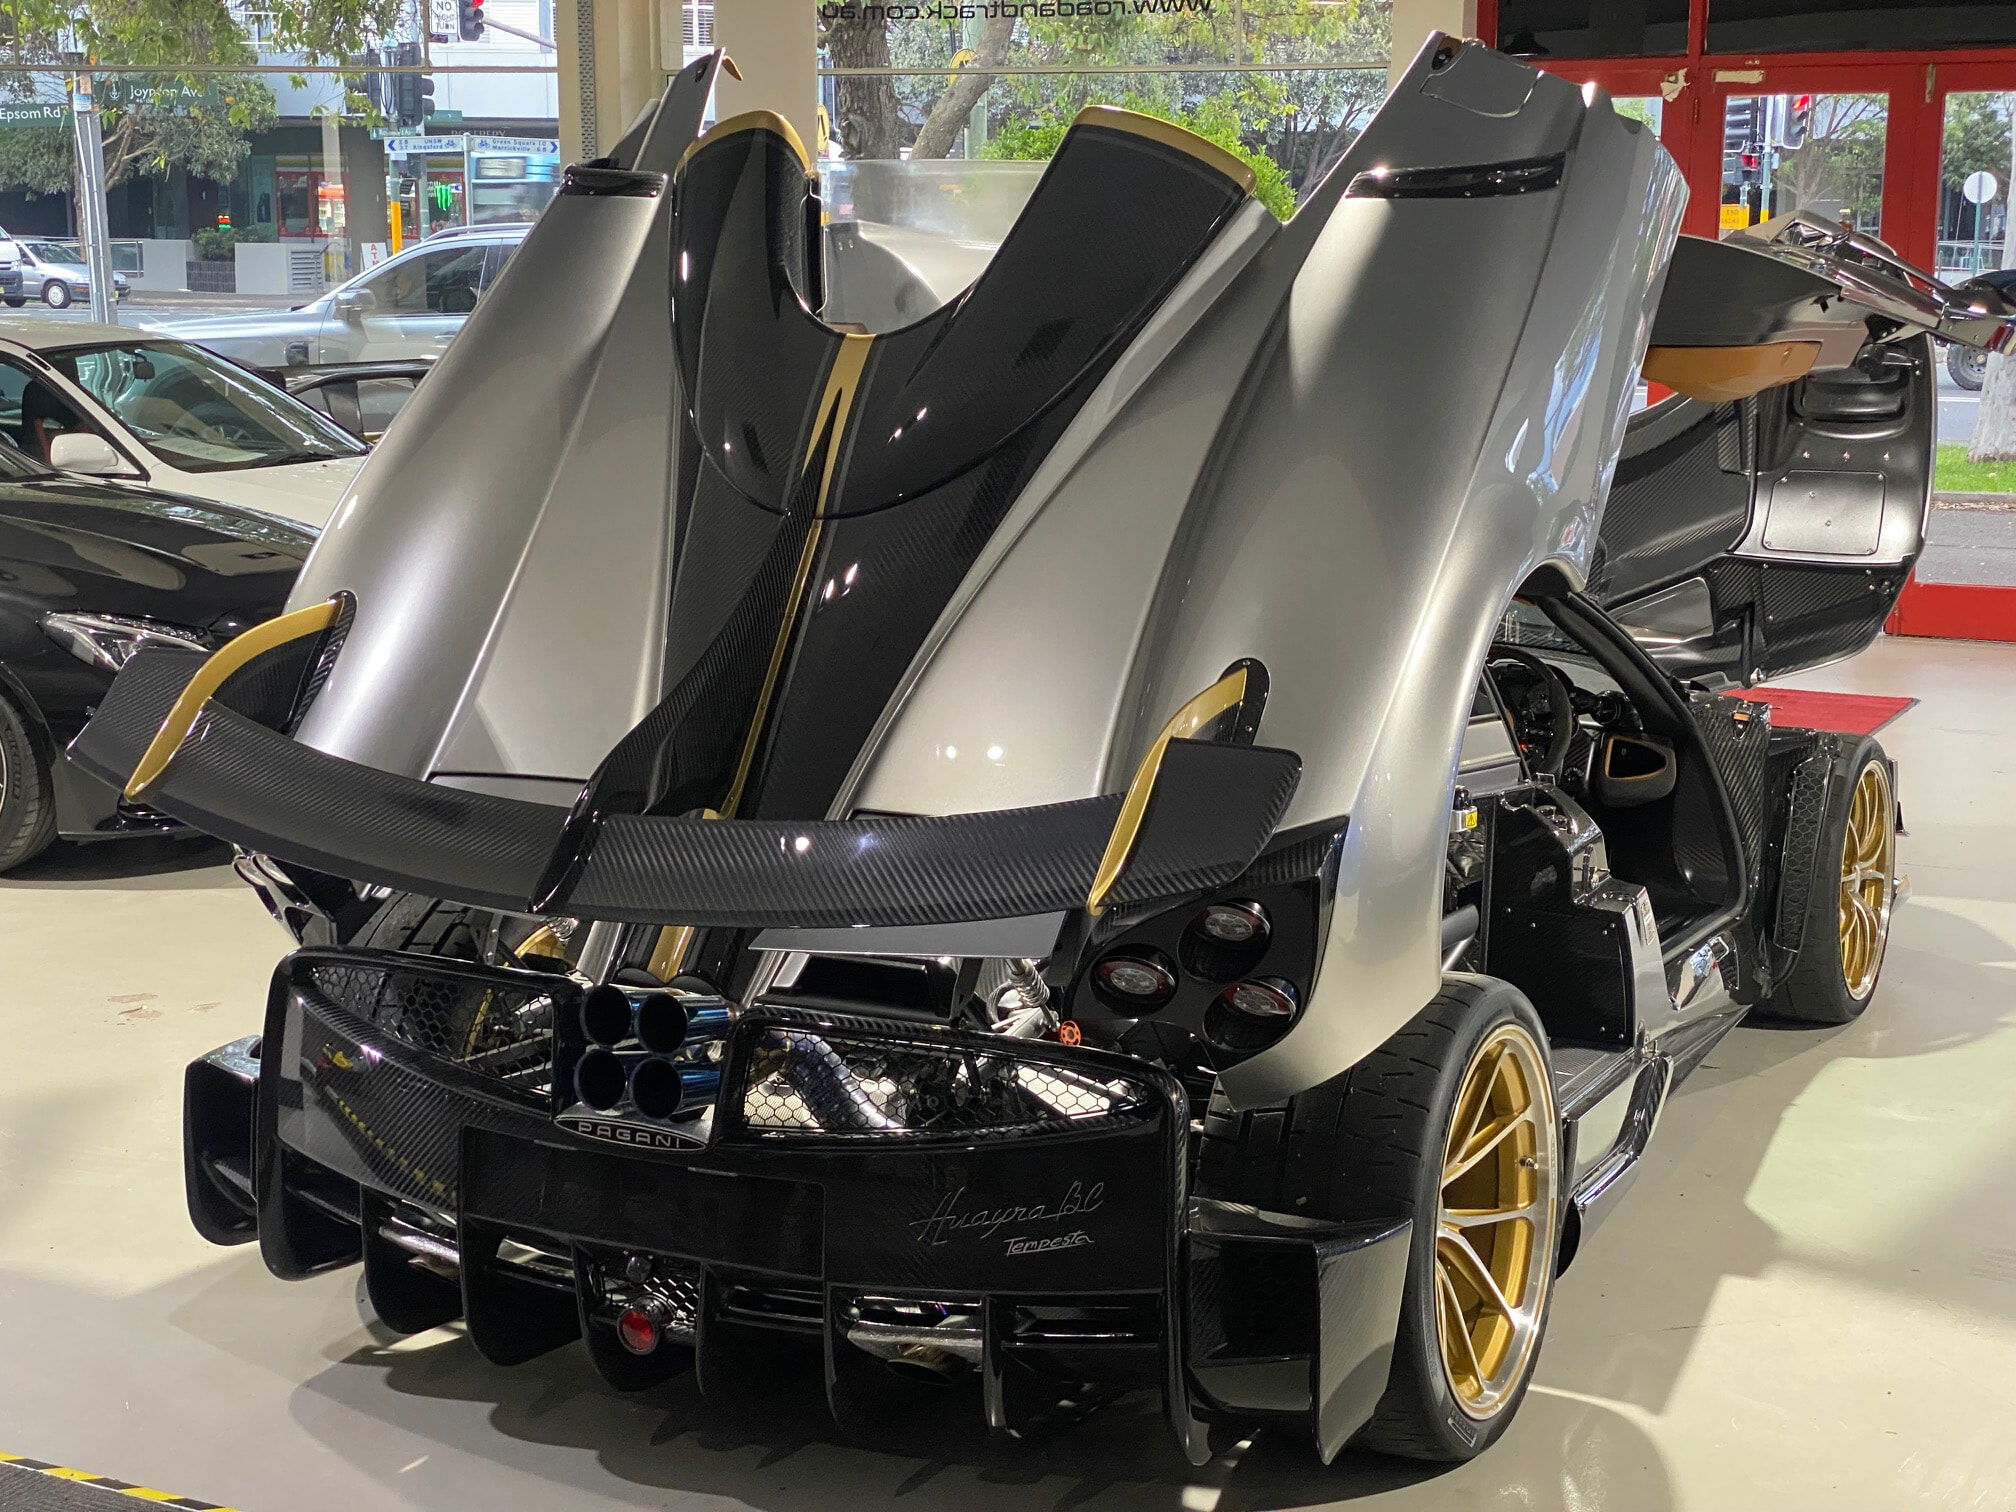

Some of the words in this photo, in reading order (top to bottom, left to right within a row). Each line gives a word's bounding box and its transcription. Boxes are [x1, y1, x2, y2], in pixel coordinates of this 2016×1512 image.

[437, 1, 451, 10] NO
[130, 85, 177, 99] Joynon
[181, 86, 204, 98] Av
[0, 108, 41, 123] Epsom
[44, 105, 61, 119] Rd
[451, 129, 506, 137] ROEBERY
[492, 144, 531, 152] Marrickville
[578, 1121, 681, 1149] PAGANI
[909, 1186, 1046, 1246] Huayra
[1055, 1180, 1104, 1221] BC
[1003, 1230, 1095, 1257] Tempesta
